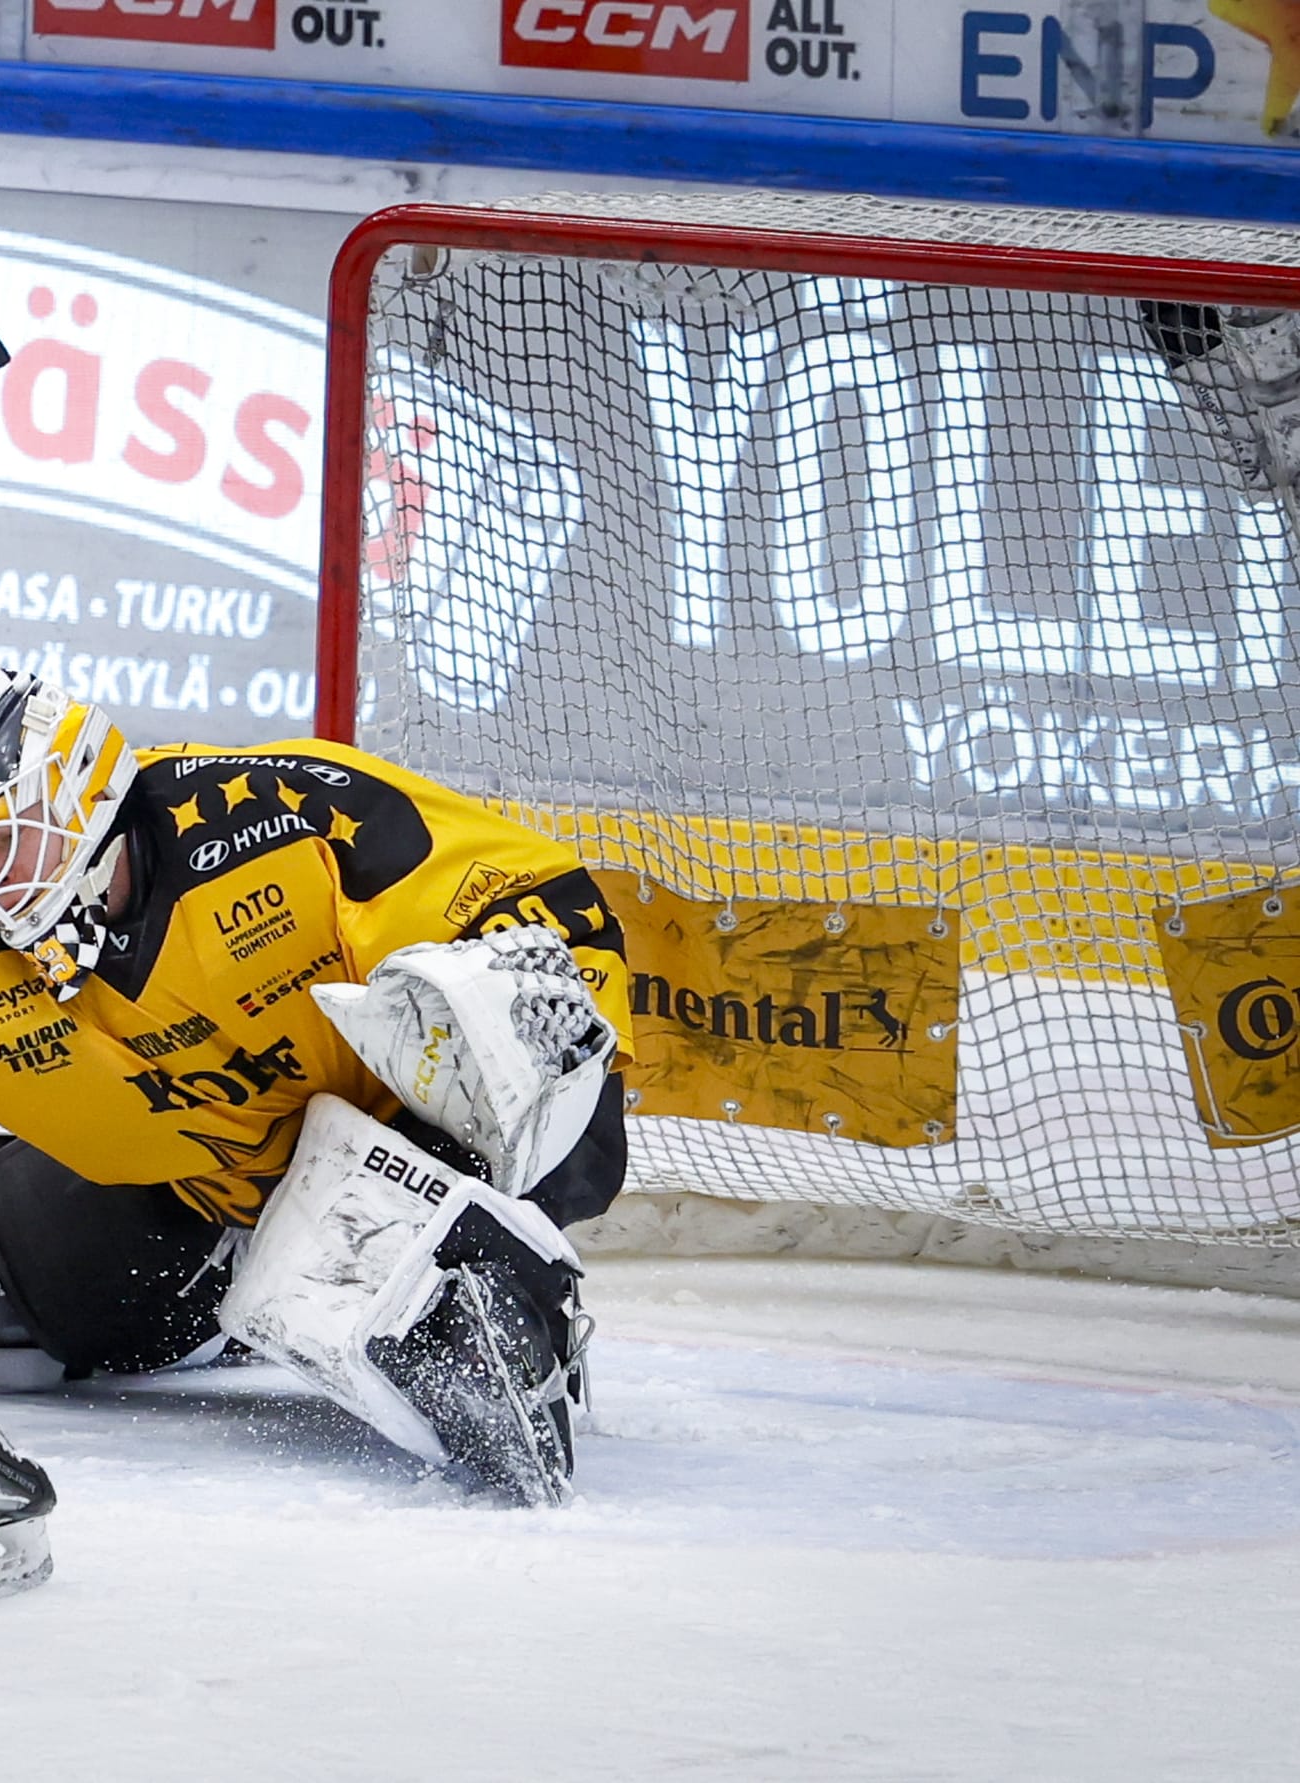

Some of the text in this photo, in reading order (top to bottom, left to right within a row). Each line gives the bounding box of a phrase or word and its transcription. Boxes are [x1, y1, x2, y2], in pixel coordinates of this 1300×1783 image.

[291, 7, 386, 48] OUT.
[512, 0, 737, 54] CCM
[767, 0, 845, 35] ALL
[765, 37, 860, 81] OUT.
[115, 579, 272, 639] TURKU
[230, 919, 298, 962] TOIMITILAT
[255, 968, 294, 994] KARELIA
[630, 971, 845, 1050] nental
[1217, 972, 1300, 1061] Co
[4, 1041, 71, 1073] TILA
